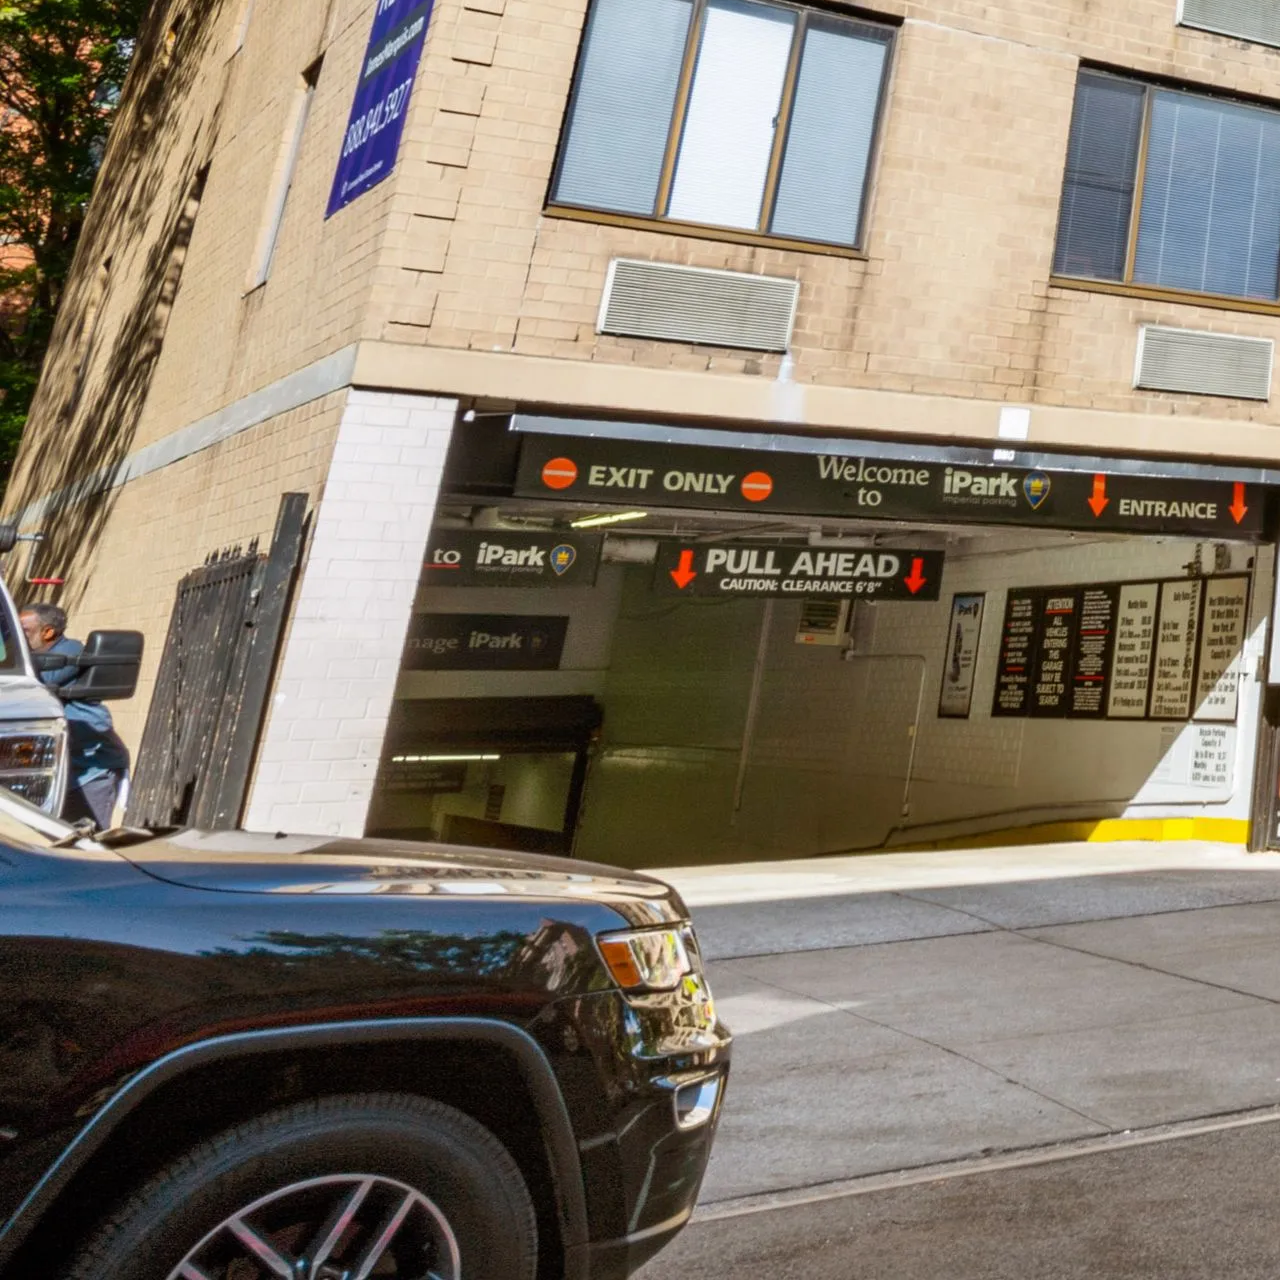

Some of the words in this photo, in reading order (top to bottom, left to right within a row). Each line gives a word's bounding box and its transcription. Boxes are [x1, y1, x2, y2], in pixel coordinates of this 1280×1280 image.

[588, 465, 653, 489] EXIT
[663, 471, 735, 494] ONLY
[816, 455, 930, 486] Welcome
[944, 467, 1018, 497] iPark
[858, 487, 882, 507] to
[1119, 498, 1218, 520] ENTRANCE
[433, 549, 461, 565] to
[476, 542, 546, 567] iPark
[705, 549, 781, 575] PULL
[789, 552, 900, 578] AHEAD
[719, 577, 778, 591] CAUTION:
[781, 579, 853, 593] CLEARANCE
[468, 631, 522, 649] iPark
